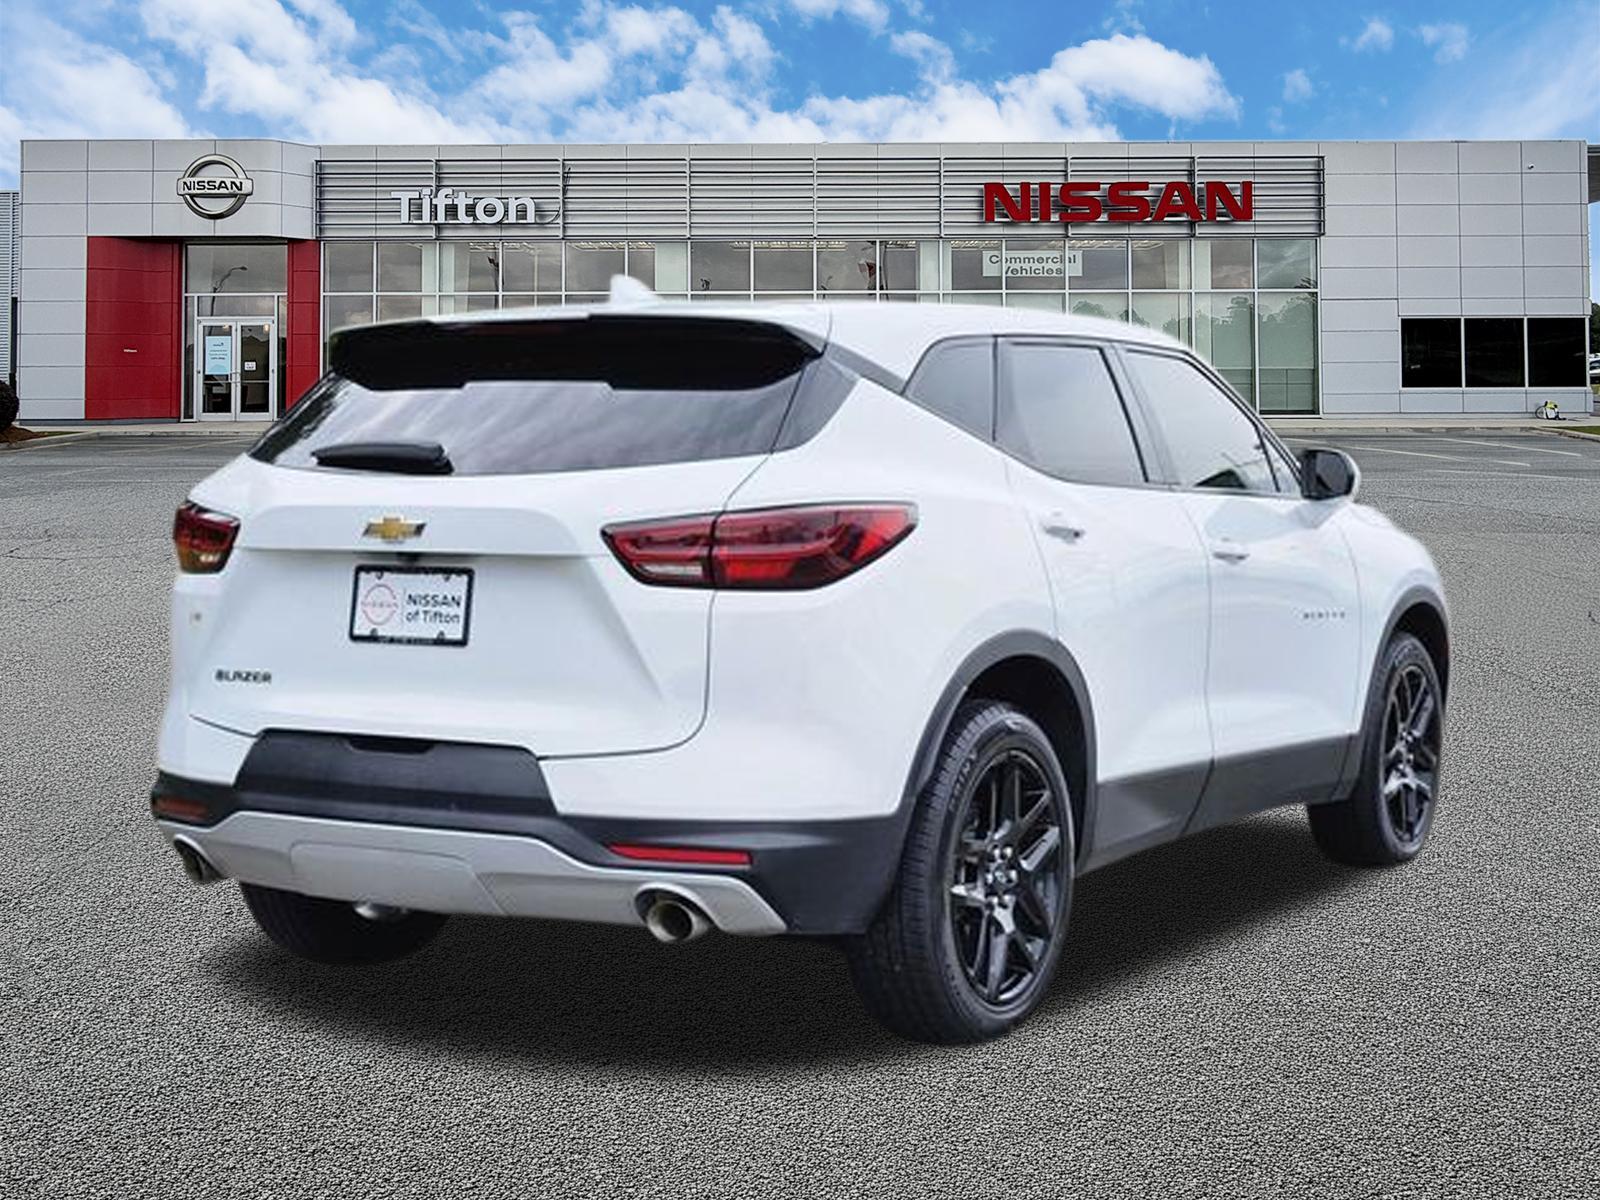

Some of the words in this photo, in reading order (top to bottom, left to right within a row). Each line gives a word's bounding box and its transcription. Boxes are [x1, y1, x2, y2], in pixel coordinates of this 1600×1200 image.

[182, 180, 243, 192] NISSAN
[390, 188, 536, 224] Tifton
[984, 181, 1253, 222] NISSAN
[406, 593, 461, 608] NISSAN
[405, 610, 419, 622] of
[422, 609, 460, 624] Tifton
[215, 669, 272, 685] BLAZER
